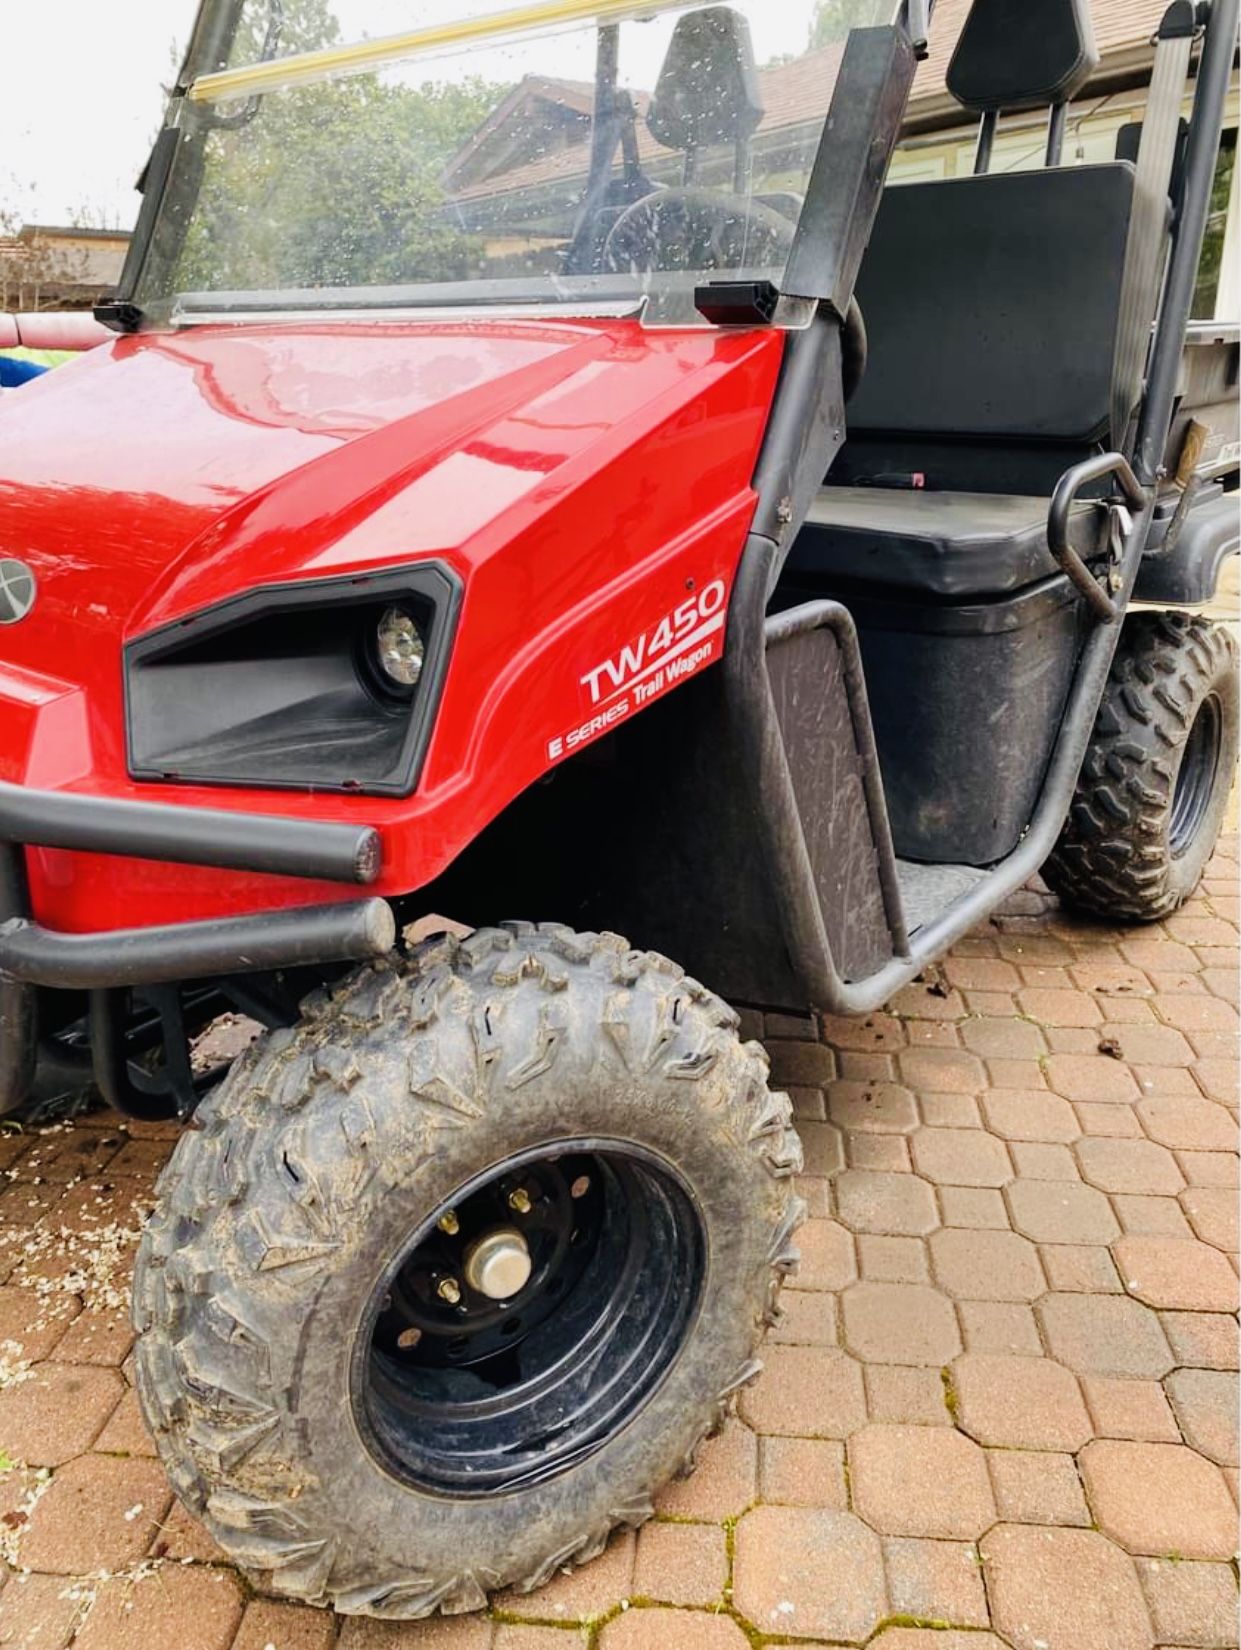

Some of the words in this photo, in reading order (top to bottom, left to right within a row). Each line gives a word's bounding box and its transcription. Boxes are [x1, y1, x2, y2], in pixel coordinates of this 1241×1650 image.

[547, 737, 563, 760] E
[565, 698, 630, 749] SERIES
[632, 671, 664, 705] Trail
[666, 641, 712, 682] Wagon
[580, 579, 725, 703] TW450
